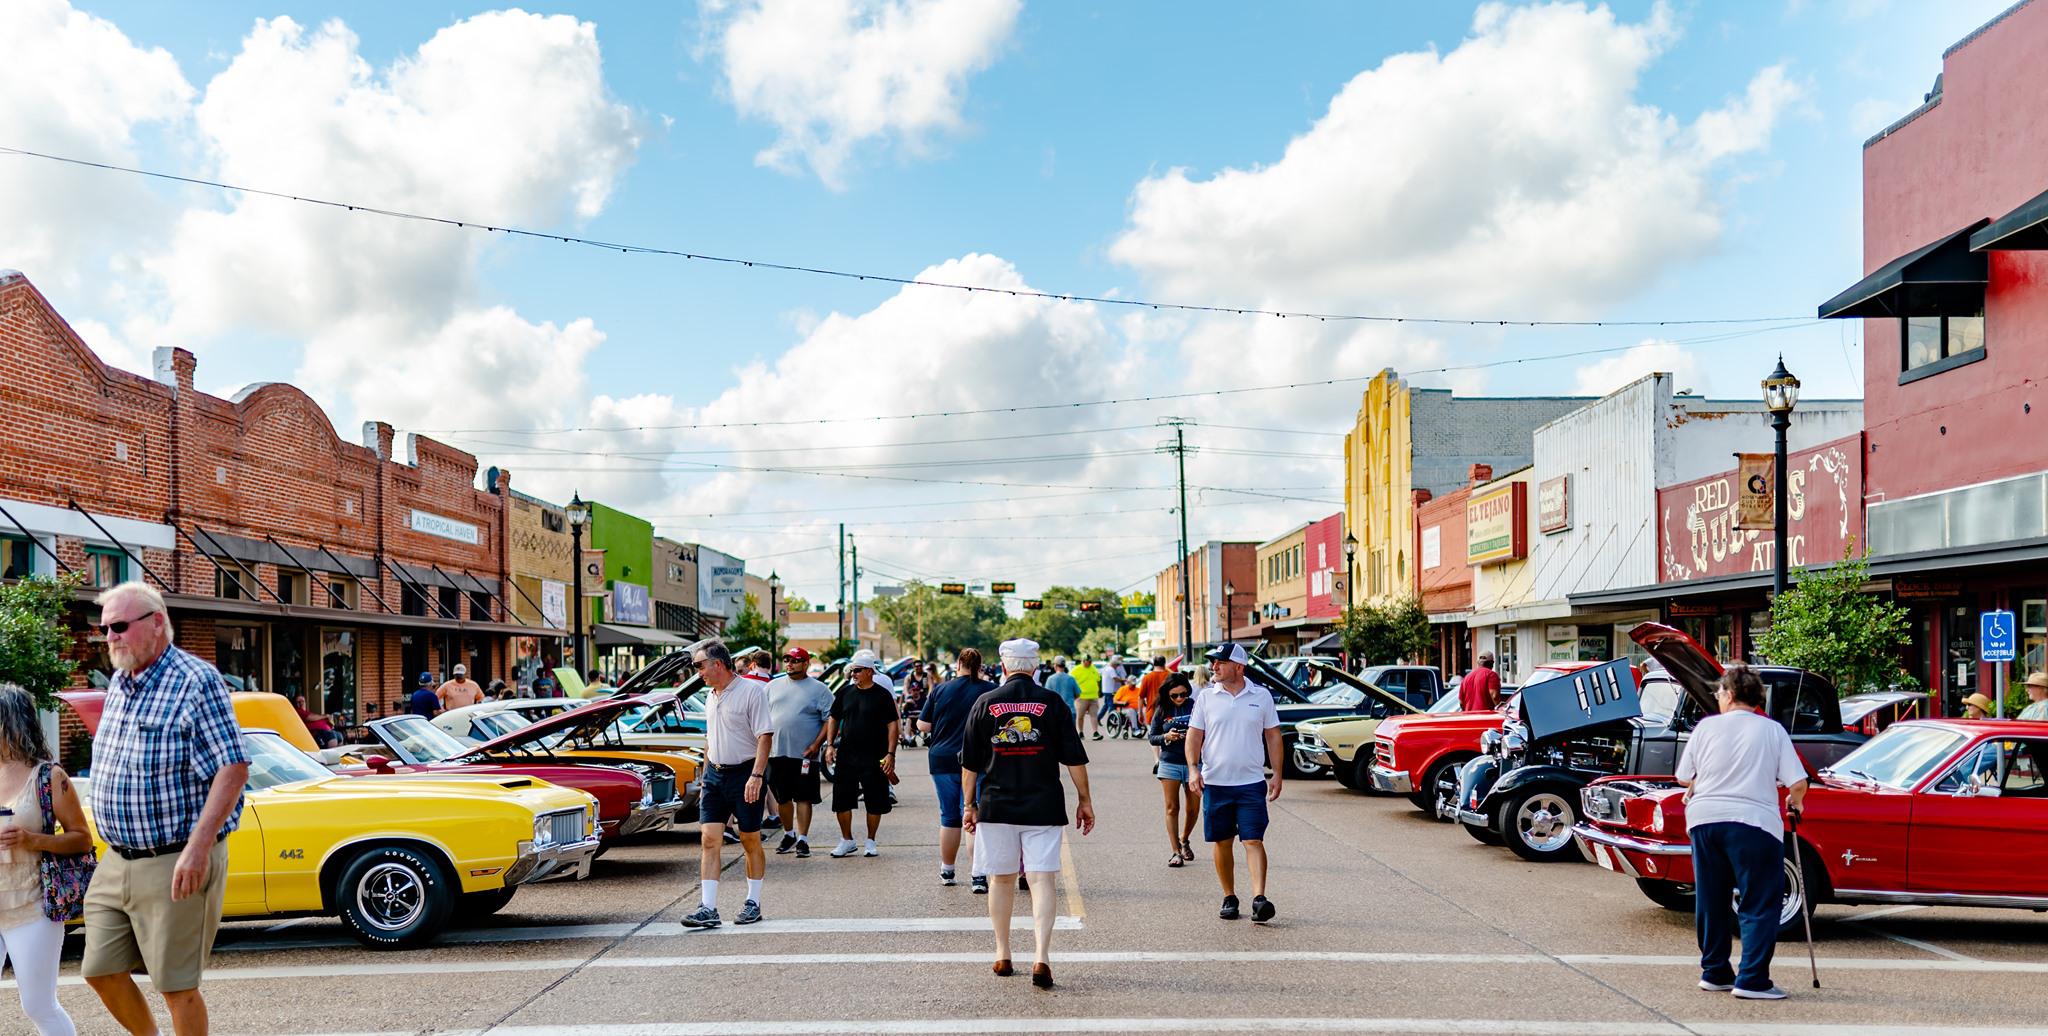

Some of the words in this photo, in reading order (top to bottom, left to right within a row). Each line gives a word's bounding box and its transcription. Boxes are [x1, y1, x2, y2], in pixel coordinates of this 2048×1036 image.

[1469, 506, 1478, 524] EL
[1479, 495, 1510, 522] TEJANO
[1695, 479, 1730, 514] RED
[415, 515, 421, 527] A
[422, 517, 454, 536] TROPICAL
[454, 525, 475, 540] HAVEN
[1751, 535, 1805, 573] ATIC
[989, 702, 1048, 719] GOODGUYS
[279, 848, 304, 860] 442
[384, 850, 434, 885] GOODYEAR
